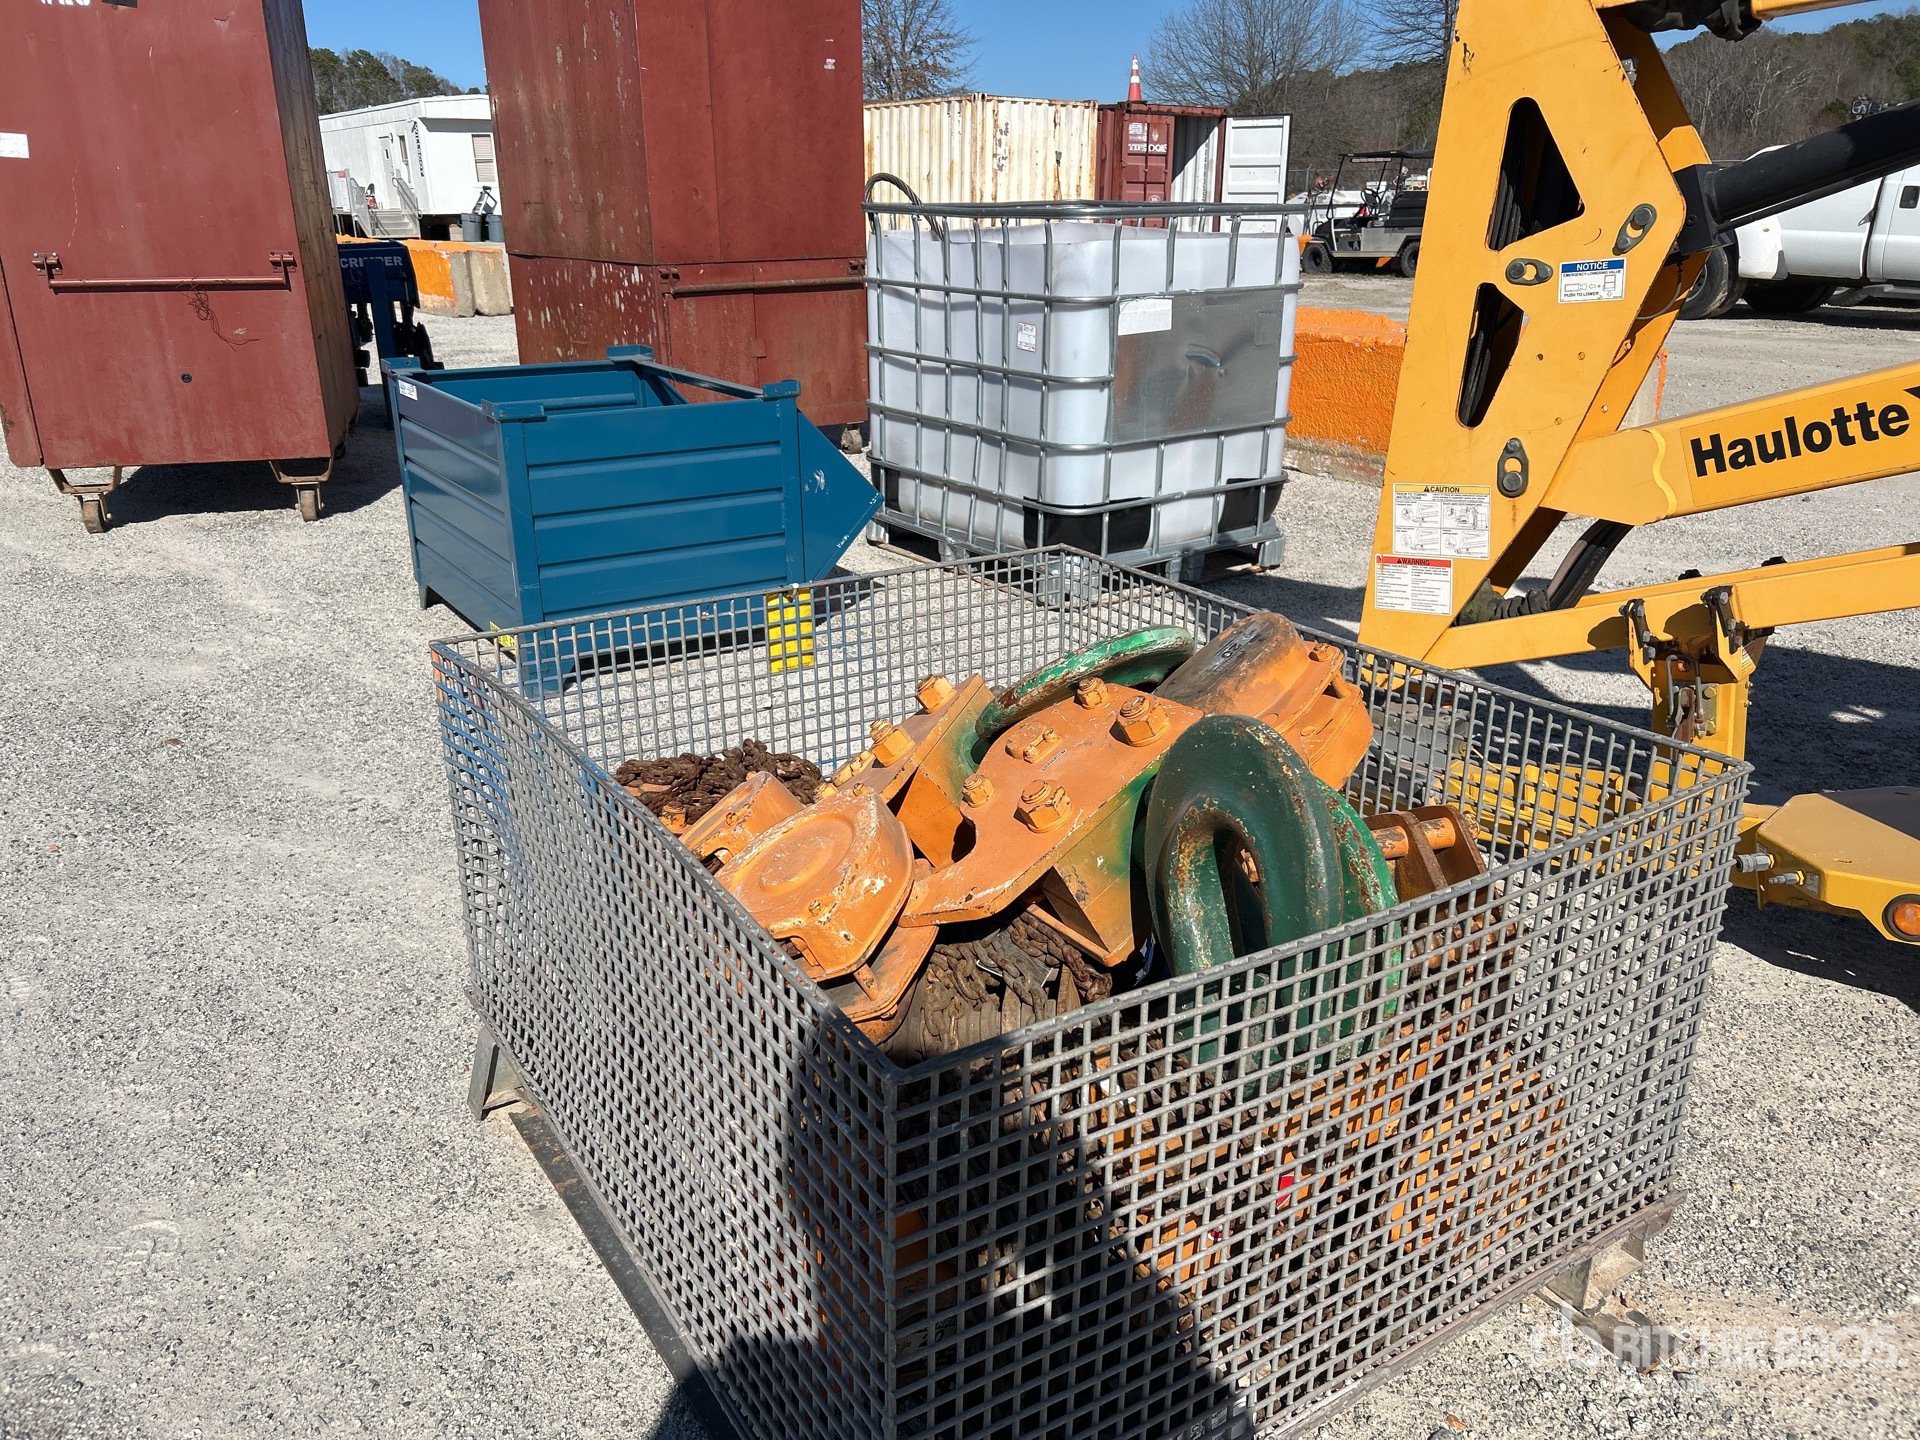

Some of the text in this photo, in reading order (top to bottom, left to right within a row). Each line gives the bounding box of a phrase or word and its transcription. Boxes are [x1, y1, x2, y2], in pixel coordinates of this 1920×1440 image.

[340, 256, 403, 268] CRIER
[1576, 262, 1609, 271] NOTICE
[1690, 401, 1910, 477] Haulotte
[1401, 558, 1430, 566] WARNING
